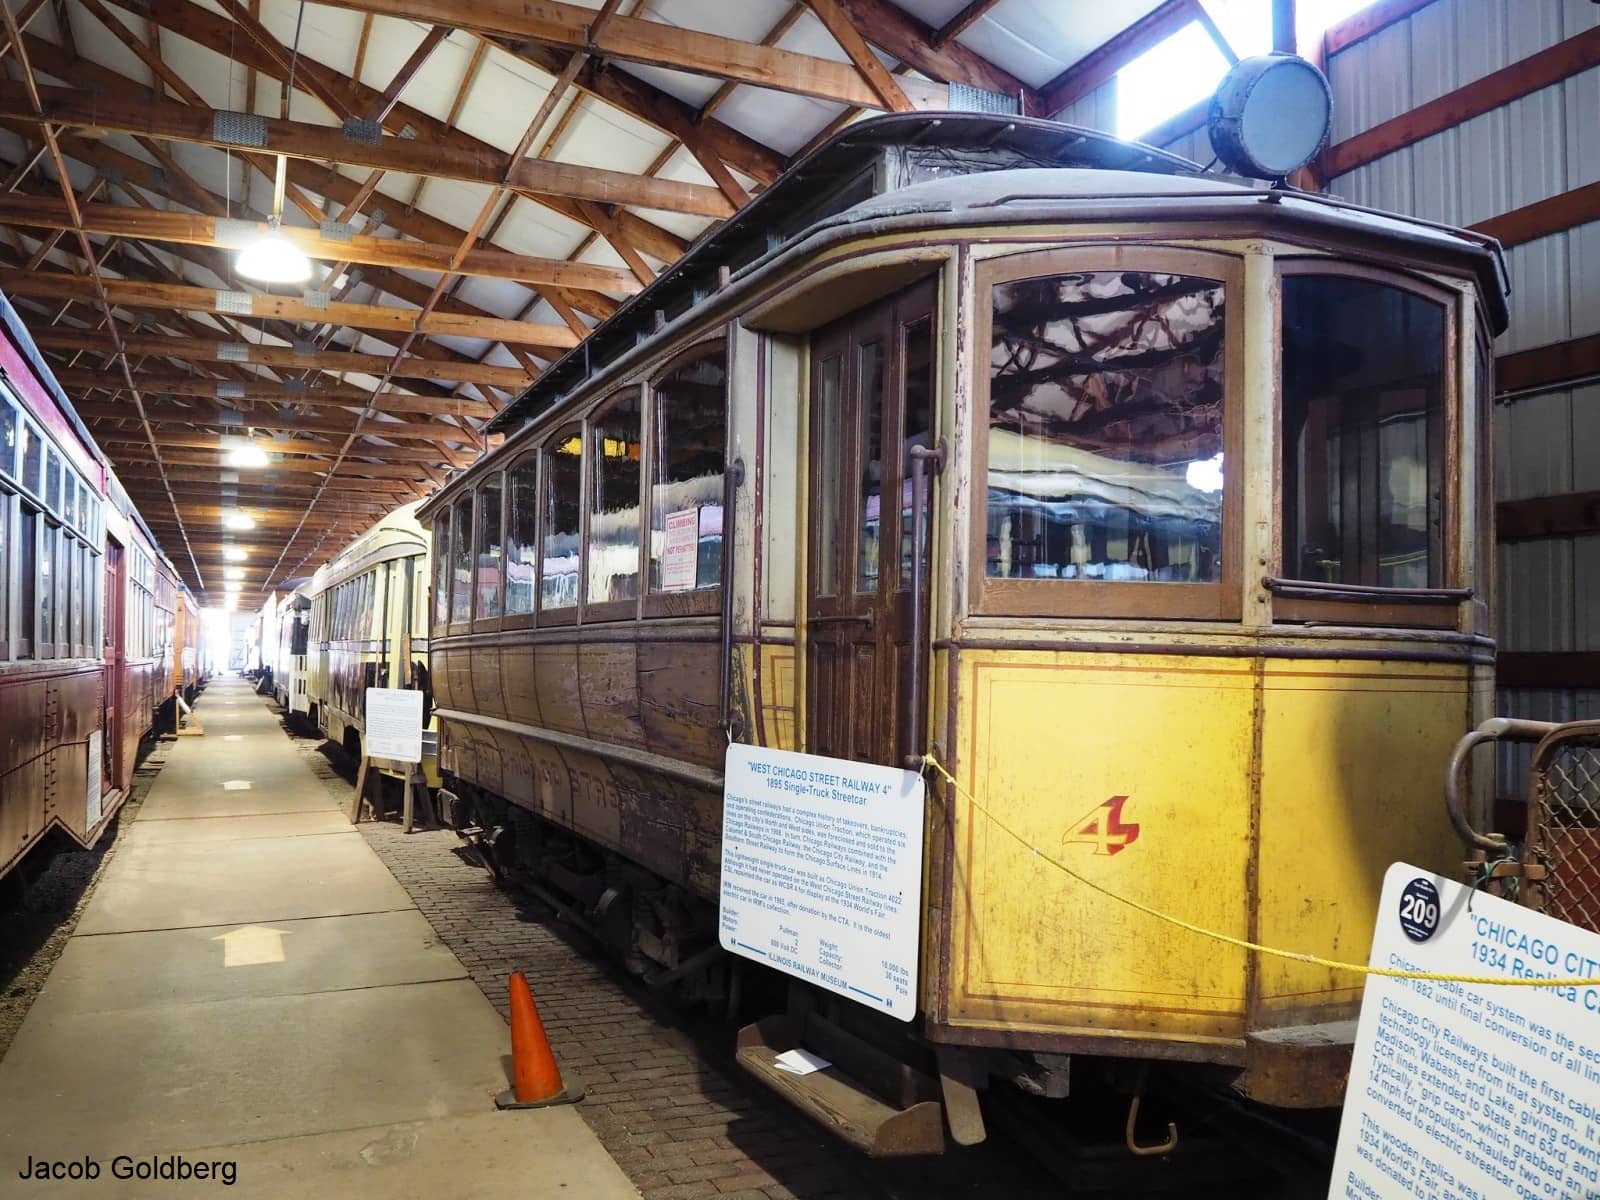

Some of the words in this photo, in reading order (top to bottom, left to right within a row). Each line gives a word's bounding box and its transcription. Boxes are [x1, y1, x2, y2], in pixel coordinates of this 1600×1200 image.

[747, 761, 770, 774] "WEST
[772, 766, 808, 781] CHICAGO
[809, 772, 840, 786] STREET
[842, 777, 880, 794] RAILWAY
[767, 777, 782, 789] 1895
[784, 781, 829, 798] Single-Truck
[831, 789, 867, 805] Streetcar
[1062, 795, 1139, 856] 4
[865, 888, 887, 901] Traction
[1400, 894, 1437, 928] 209
[873, 929, 891, 940] oldest
[1470, 914, 1559, 965] "CHICAGO
[1471, 942, 1507, 971] 1934
[768, 952, 793, 968] ILLINOIS
[793, 961, 820, 979] RAILWAY
[821, 972, 848, 990] MUSEUM
[1411, 979, 1433, 999] 1882
[1435, 993, 1458, 1012] until
[1459, 1003, 1483, 1025] final
[1484, 1018, 1548, 1058] conversion
[1549, 1050, 1565, 1066] of
[1566, 1058, 1583, 1075] all
[1466, 992, 1484, 1008] car
[1486, 1001, 1526, 1028] system
[1529, 1022, 1552, 1041] was
[1555, 1031, 1575, 1052] the
[1376, 1025, 1417, 1060] Madison,
[1419, 1050, 1462, 1086] Wabash,
[1464, 1078, 1486, 1097] and
[1487, 1089, 1517, 1118] Lake,
[1519, 1110, 1558, 1142] giving
[1379, 1010, 1431, 1052] technology
[1433, 1040, 1476, 1074] licensed
[1477, 1065, 1503, 1090] from
[1505, 1080, 1529, 1104] that
[1529, 1097, 1577, 1132] system.
[1585, 1125, 1595, 1141] It
[1381, 996, 1420, 1026] Chicago
[1420, 1016, 1441, 1040] City
[1442, 1028, 1489, 1064] Railways
[1491, 1054, 1517, 1078] built
[1519, 1069, 1538, 1090] the
[1539, 1080, 1566, 1105] first
[1567, 1097, 1600, 1125] cable
[1366, 1087, 1413, 1123] converted
[1413, 1115, 1424, 1131] to
[1425, 1125, 1463, 1156] electric
[1464, 1150, 1514, 1190] streetcar
[1368, 1069, 1380, 1085] 14
[1380, 1079, 1402, 1099] mph
[1402, 1091, 1417, 1108] for
[1518, 1163, 1541, 1188] two
[1542, 1181, 1558, 1198] or
[1371, 1054, 1414, 1092] Typically,
[1417, 1082, 1442, 1109] "grip
[1512, 1143, 1564, 1182] grabbed
[1566, 1175, 1583, 1194] an
[1373, 1040, 1395, 1061] CCR
[1396, 1053, 1419, 1076] lines
[1420, 1070, 1468, 1105] extended
[1468, 1096, 1480, 1113] to
[1482, 1104, 1511, 1131] State
[1512, 1124, 1536, 1146] and
[1538, 1137, 1569, 1169] 63rd,
[1572, 1159, 1599, 1184] and
[1355, 1144, 1374, 1163] was
[1375, 1156, 1414, 1192] donated
[1414, 1184, 1426, 1200] to
[1359, 1128, 1381, 1151] 1934
[1381, 1143, 1417, 1177] World's
[1418, 1169, 1440, 1195] Fair,
[1360, 1112, 1381, 1135] This
[1382, 1129, 1420, 1162] wooden
[1421, 1155, 1456, 1187] replica
[1457, 1180, 1478, 1200] was
